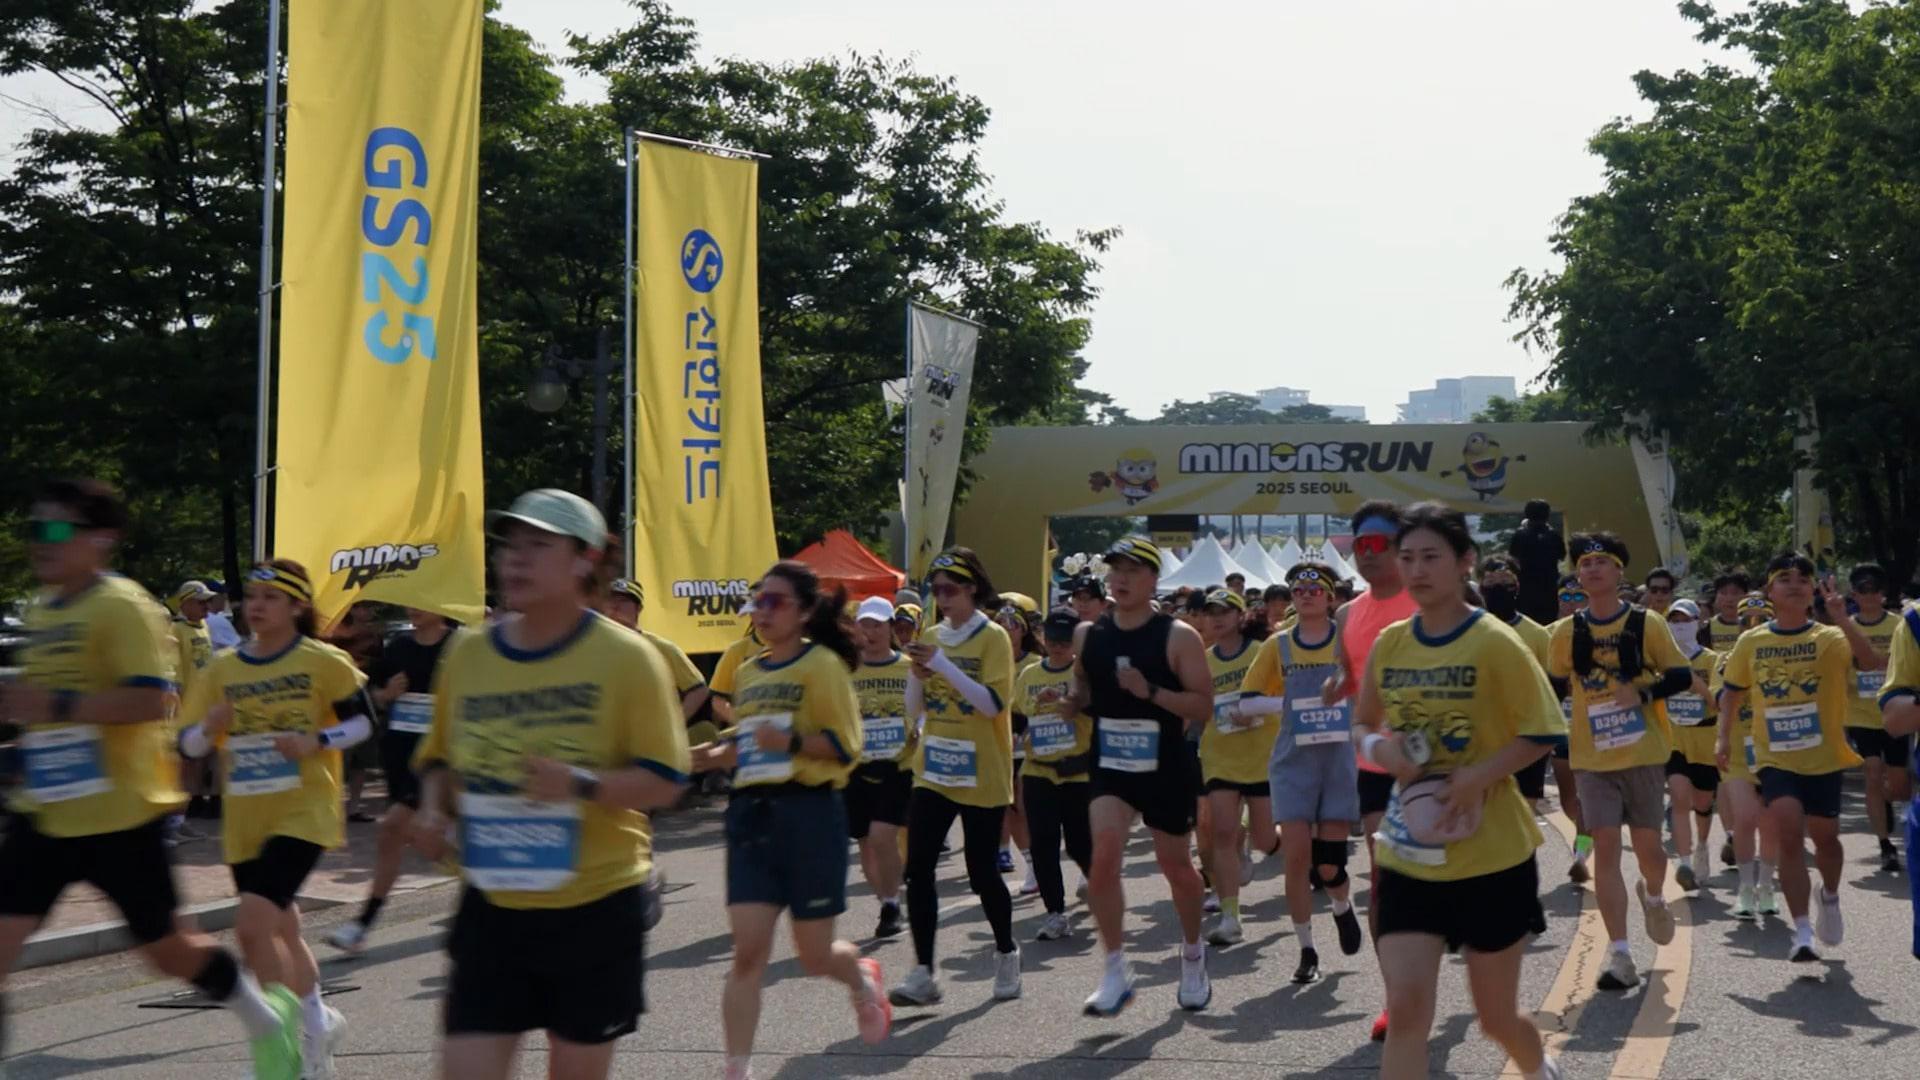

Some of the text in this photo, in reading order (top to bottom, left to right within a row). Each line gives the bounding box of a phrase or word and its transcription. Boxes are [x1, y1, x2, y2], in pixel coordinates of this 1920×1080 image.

[362, 127, 437, 365] GS25
[682, 306, 721, 504] 신한카드
[1256, 482, 1352, 494] 2025 SEOUL
[1300, 709, 1342, 724] C3279
